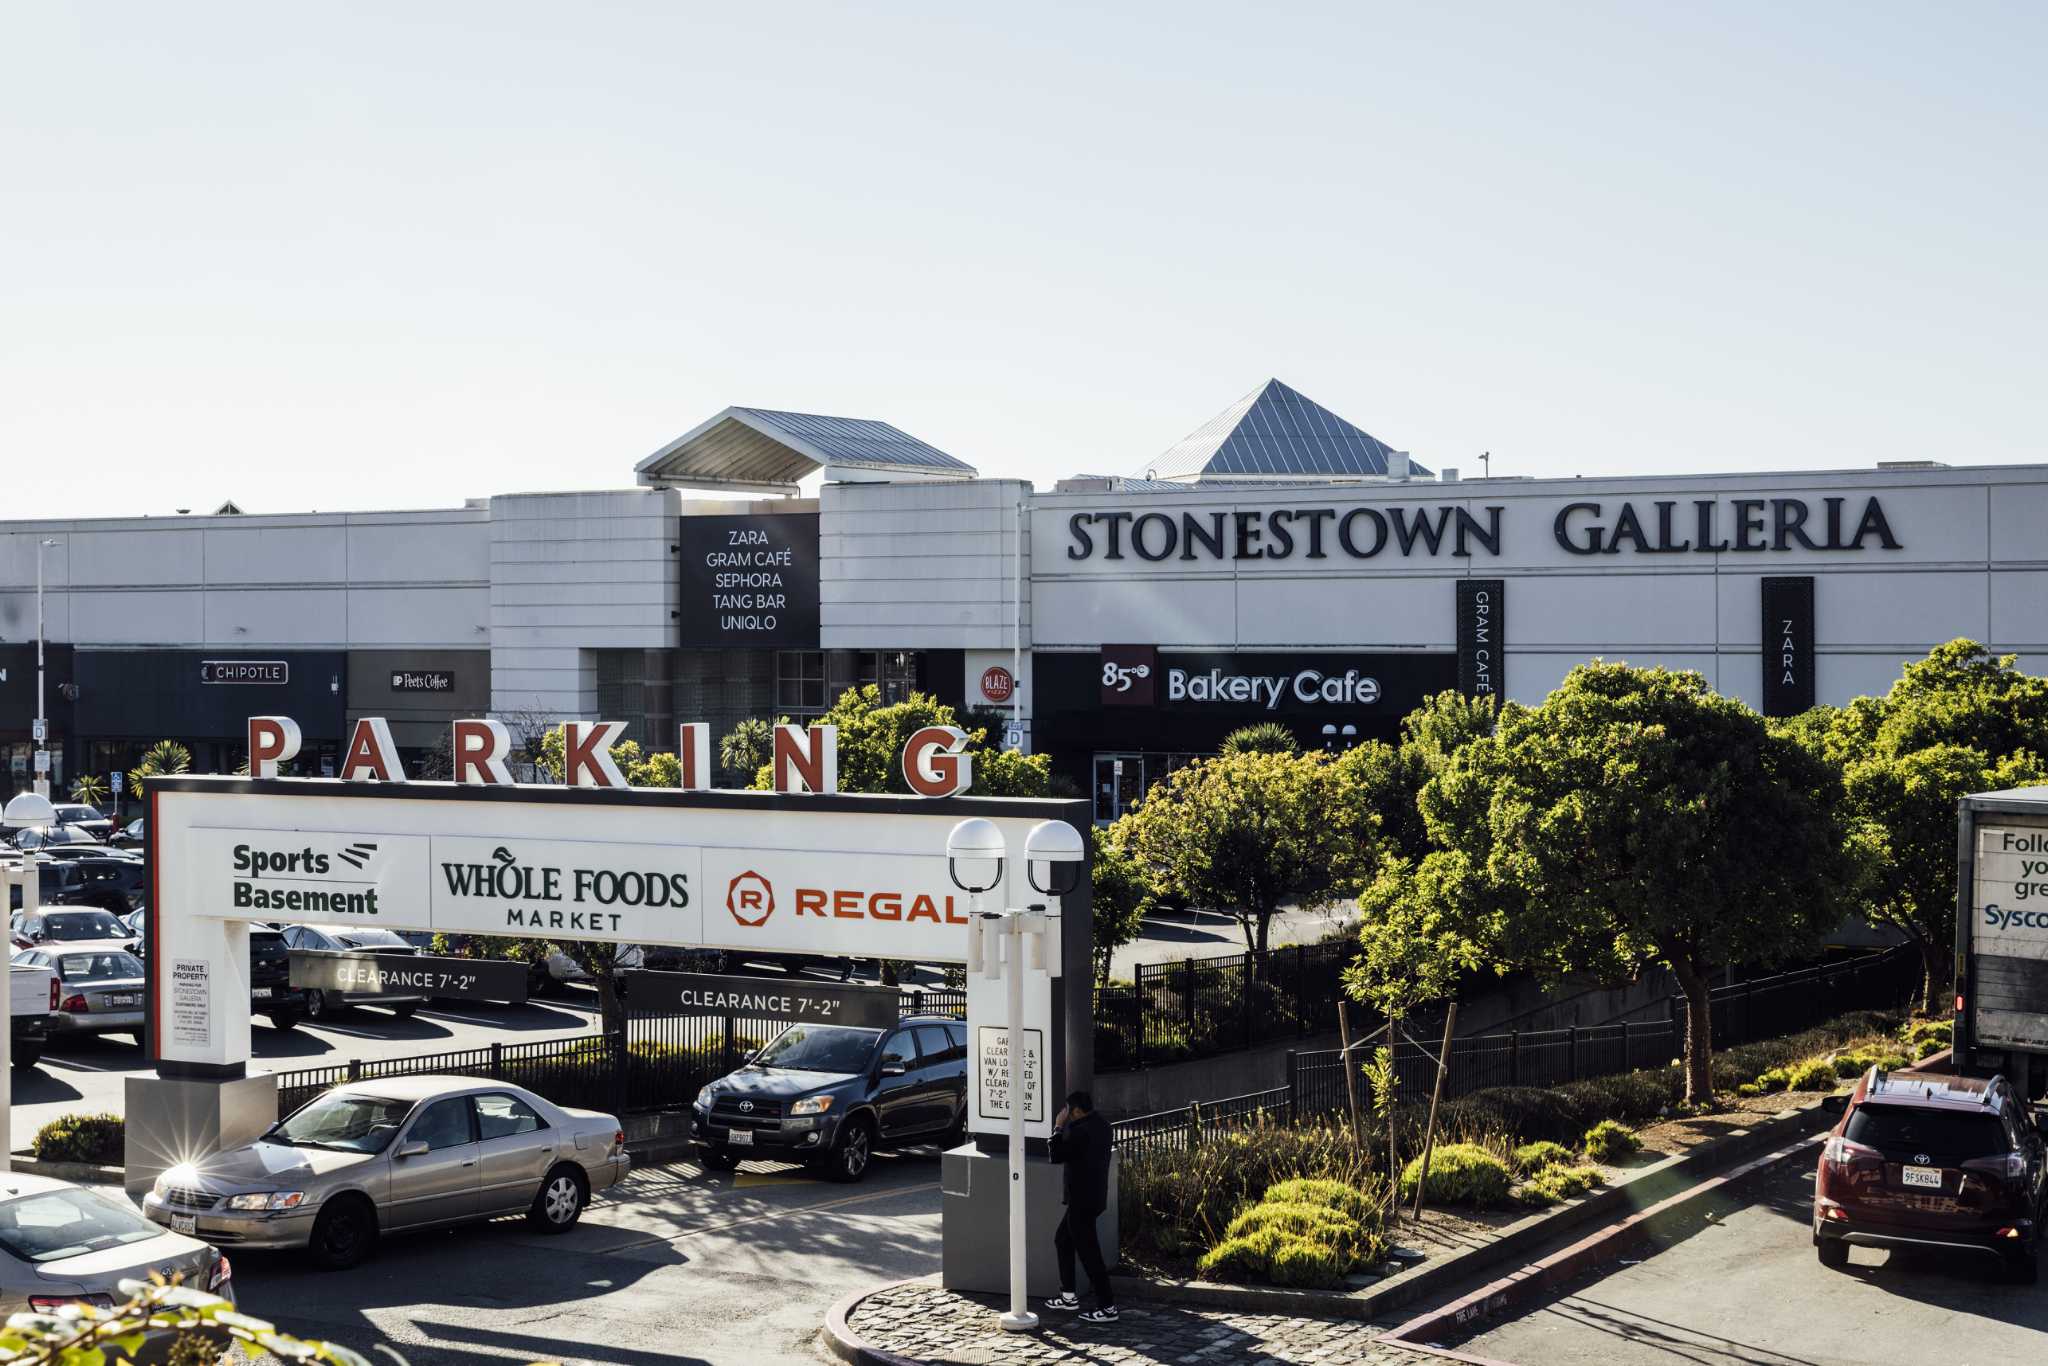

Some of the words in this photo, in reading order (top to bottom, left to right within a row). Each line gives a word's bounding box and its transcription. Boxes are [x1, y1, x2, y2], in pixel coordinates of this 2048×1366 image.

[729, 531, 769, 545] ZARA
[1067, 506, 1505, 561] STONESTOWN
[1553, 496, 1904, 555] GALLERIA
[706, 552, 751, 567] GRAM
[754, 547, 792, 566] CAFÉ
[715, 573, 783, 588] SEPHORA
[713, 594, 752, 609] TANG
[756, 594, 786, 609] BAR
[721, 615, 777, 630] UNIQLO
[1476, 591, 1489, 643] GRAM
[1782, 620, 1795, 685] ZARA
[216, 666, 281, 680] CHIPOTLE
[425, 673, 448, 689] Coffee
[985, 675, 1008, 690] BLAZE
[1168, 668, 1289, 709] Bakery
[1293, 668, 1380, 704] Cafe
[1010, 731, 1020, 744] D
[248, 716, 972, 799] PARKING
[2003, 833, 2048, 852] Foll
[233, 844, 330, 877] Sports
[441, 857, 562, 901] WHOLE
[573, 869, 689, 908] FOODS
[233, 882, 378, 915] Basement
[795, 888, 968, 925] REGAL
[507, 908, 622, 931] MARKET
[1985, 904, 2048, 930] Sysco
[172, 971, 208, 981] PROPERTY
[176, 964, 205, 973] PRIVATE
[336, 967, 434, 988] CLEARANCE
[681, 990, 791, 1013] CLEARANCE
[983, 1057, 997, 1066] VAN
[990, 1099, 1003, 1109] THE
